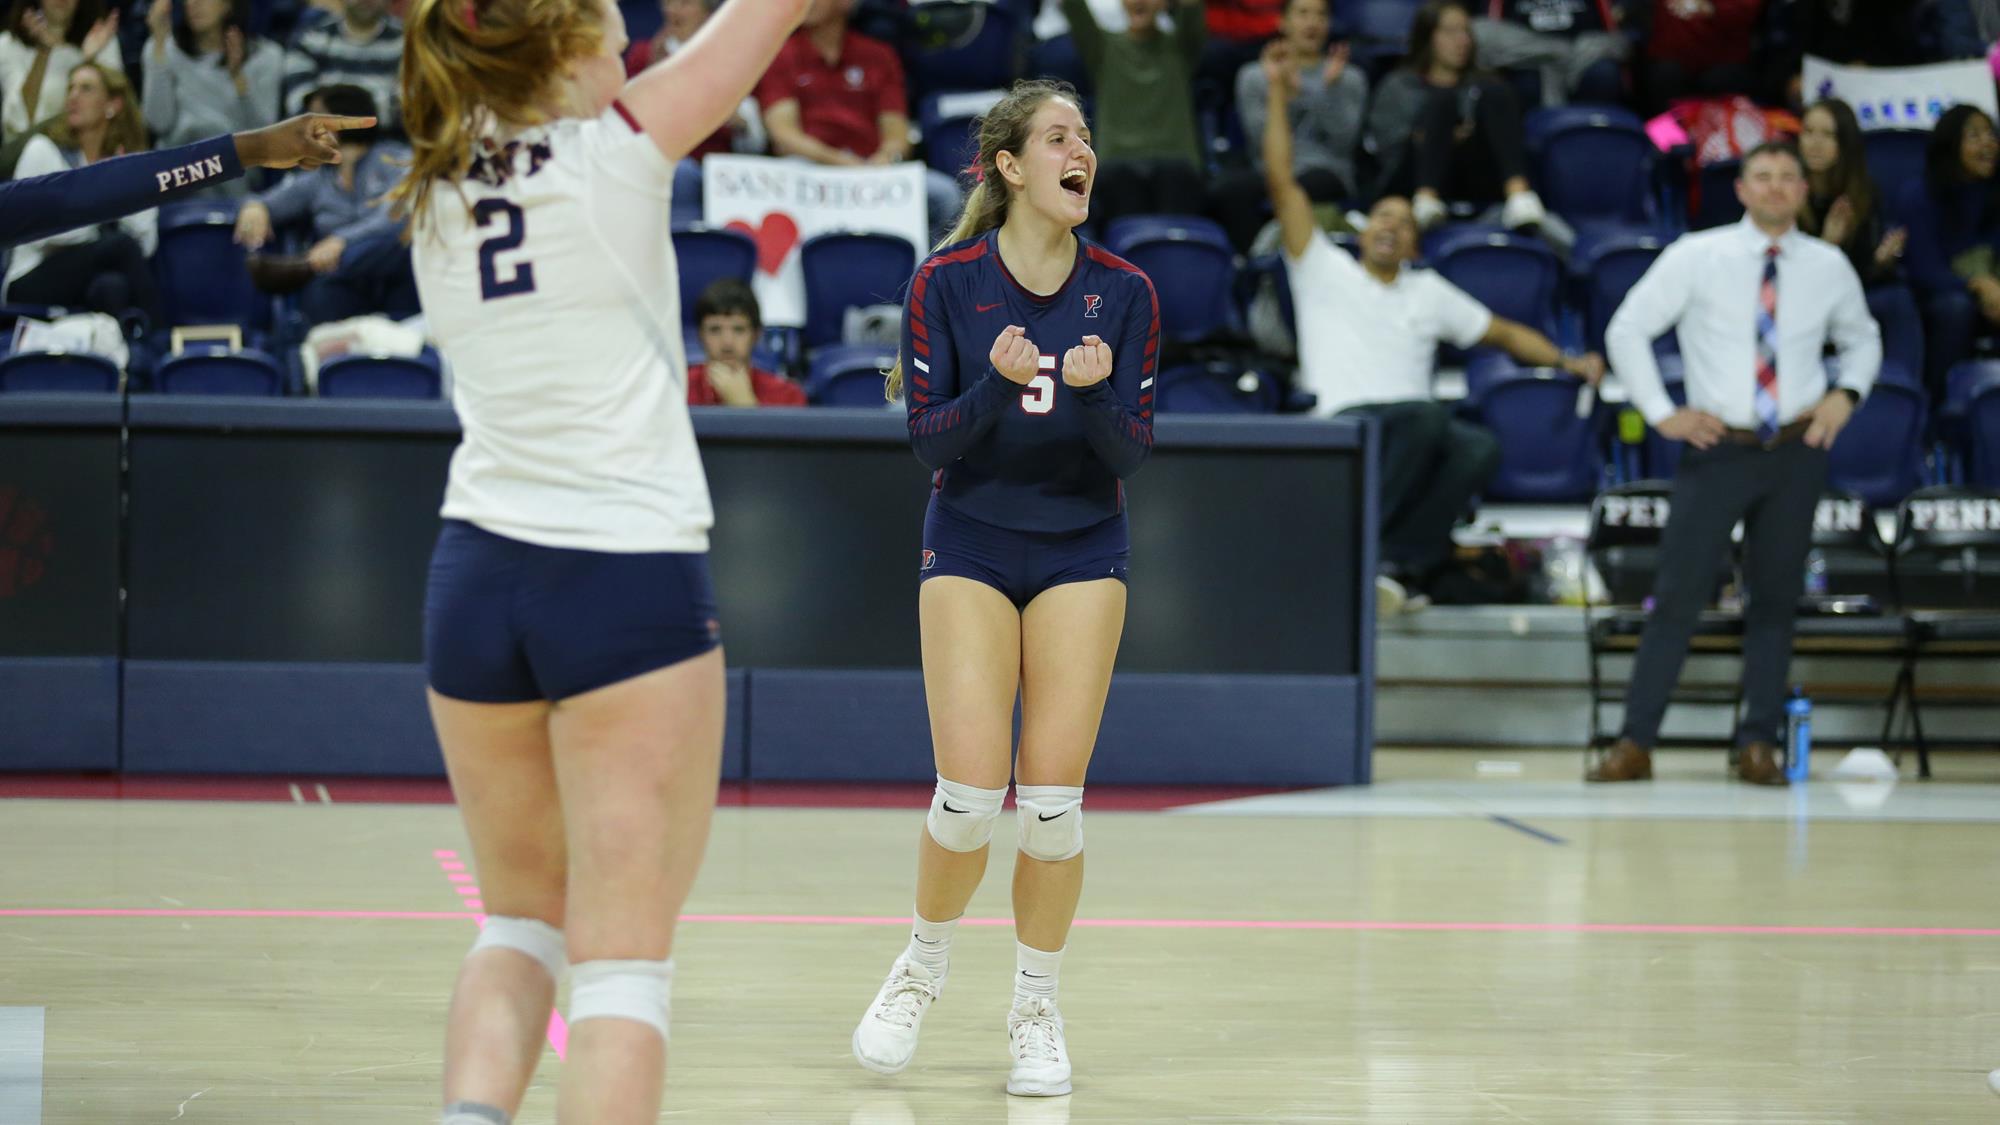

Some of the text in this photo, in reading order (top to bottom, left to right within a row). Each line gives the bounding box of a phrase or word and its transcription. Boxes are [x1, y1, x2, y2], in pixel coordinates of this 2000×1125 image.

[155, 154, 224, 193] PENN
[715, 166, 914, 209] SAN DIEGO
[474, 198, 537, 301] 2
[1083, 294, 1103, 318] P
[1020, 353, 1058, 416] 5
[1602, 496, 1671, 528] PEN
[1812, 499, 1863, 531] NN
